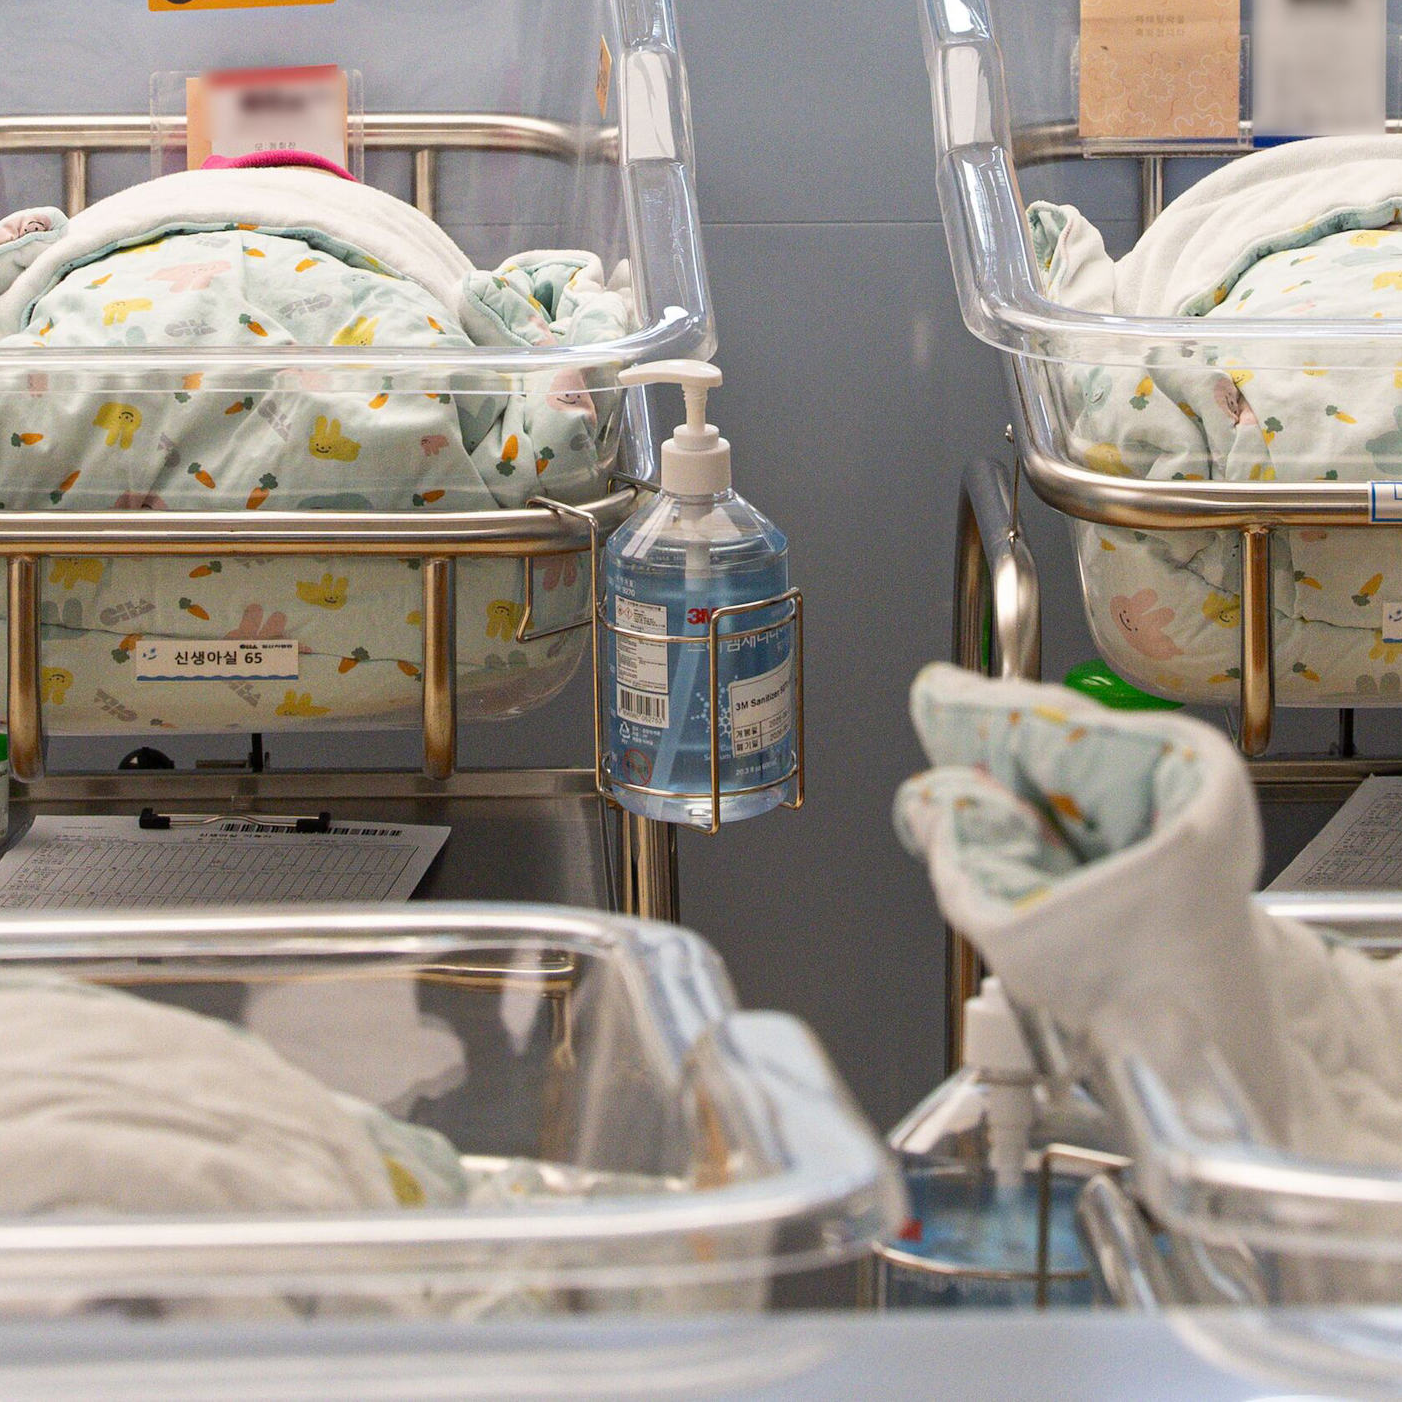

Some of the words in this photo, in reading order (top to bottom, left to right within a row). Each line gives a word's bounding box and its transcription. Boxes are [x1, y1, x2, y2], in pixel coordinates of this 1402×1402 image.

[686, 608, 718, 625] 3M
[174, 651, 238, 665] 신생아실
[244, 652, 263, 664] 65
[735, 701, 749, 711] 3M
[750, 689, 780, 707] Sanitizer
